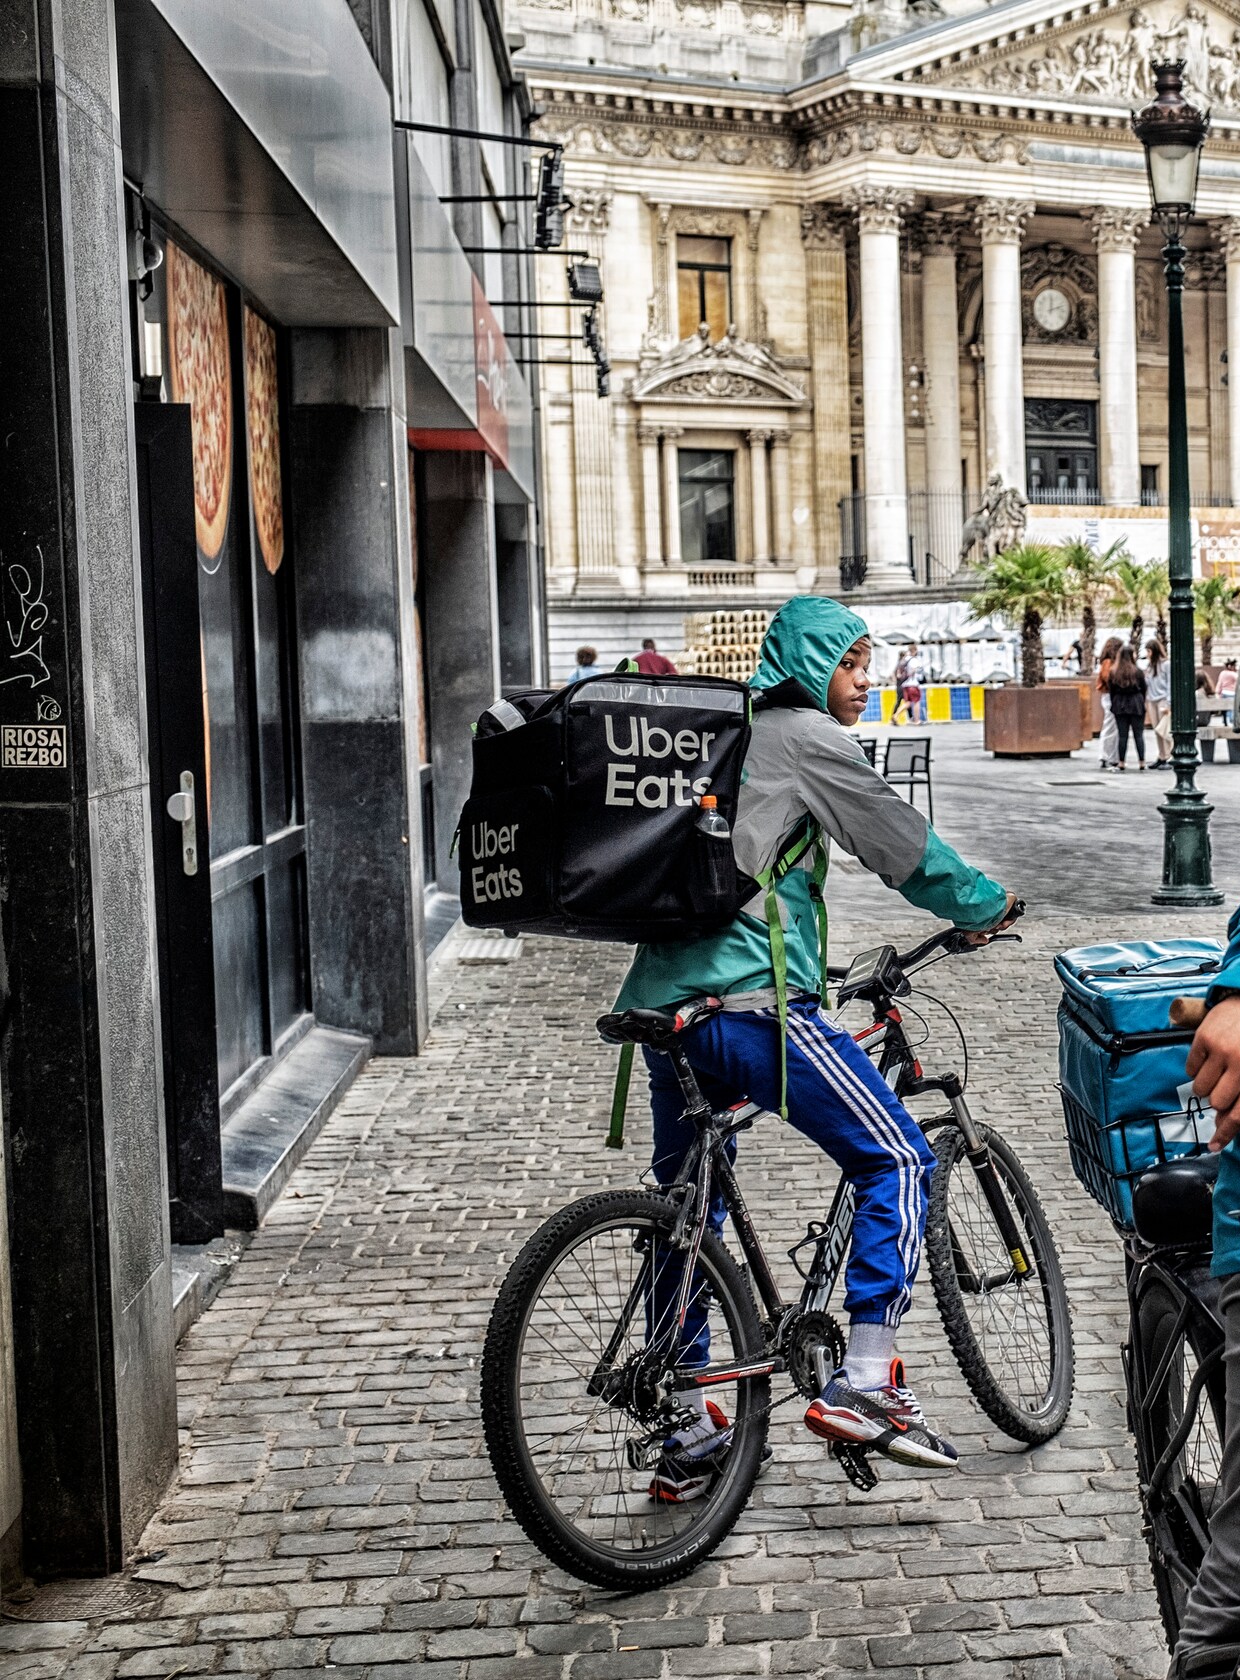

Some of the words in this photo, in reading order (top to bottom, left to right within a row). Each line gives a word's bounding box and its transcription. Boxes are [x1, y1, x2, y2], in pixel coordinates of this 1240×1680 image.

[4, 728, 62, 747] RIOSA
[4, 747, 63, 766] REZBO
[604, 714, 716, 762] Uber
[604, 763, 713, 809] Eats
[471, 821, 520, 860] Uber
[471, 863, 524, 904] Eats
